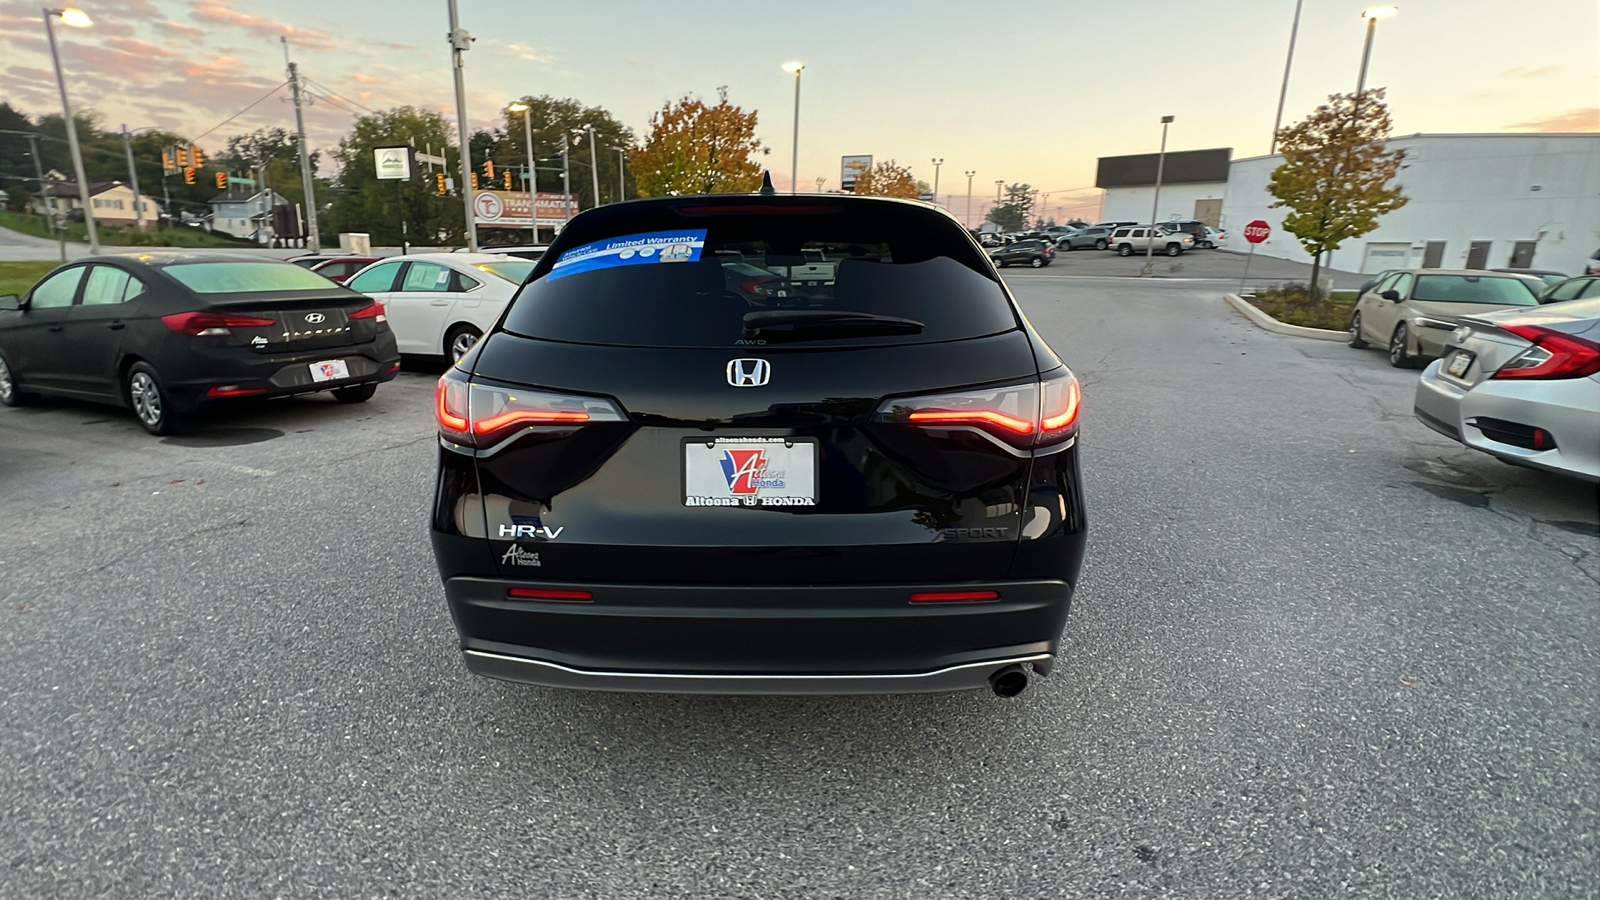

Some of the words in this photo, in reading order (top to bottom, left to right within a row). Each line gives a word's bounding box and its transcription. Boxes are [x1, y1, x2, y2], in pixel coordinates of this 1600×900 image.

[1244, 226, 1270, 237] STOP
[605, 237, 646, 250] Limited
[646, 235, 698, 246] Warranty
[730, 452, 785, 489] Altoona
[752, 478, 784, 488] Honda
[685, 496, 740, 506] Altoona
[761, 497, 816, 506] HONDA
[498, 523, 564, 539] HR-V
[943, 527, 1009, 539] SPORT
[517, 559, 542, 567] Honda
